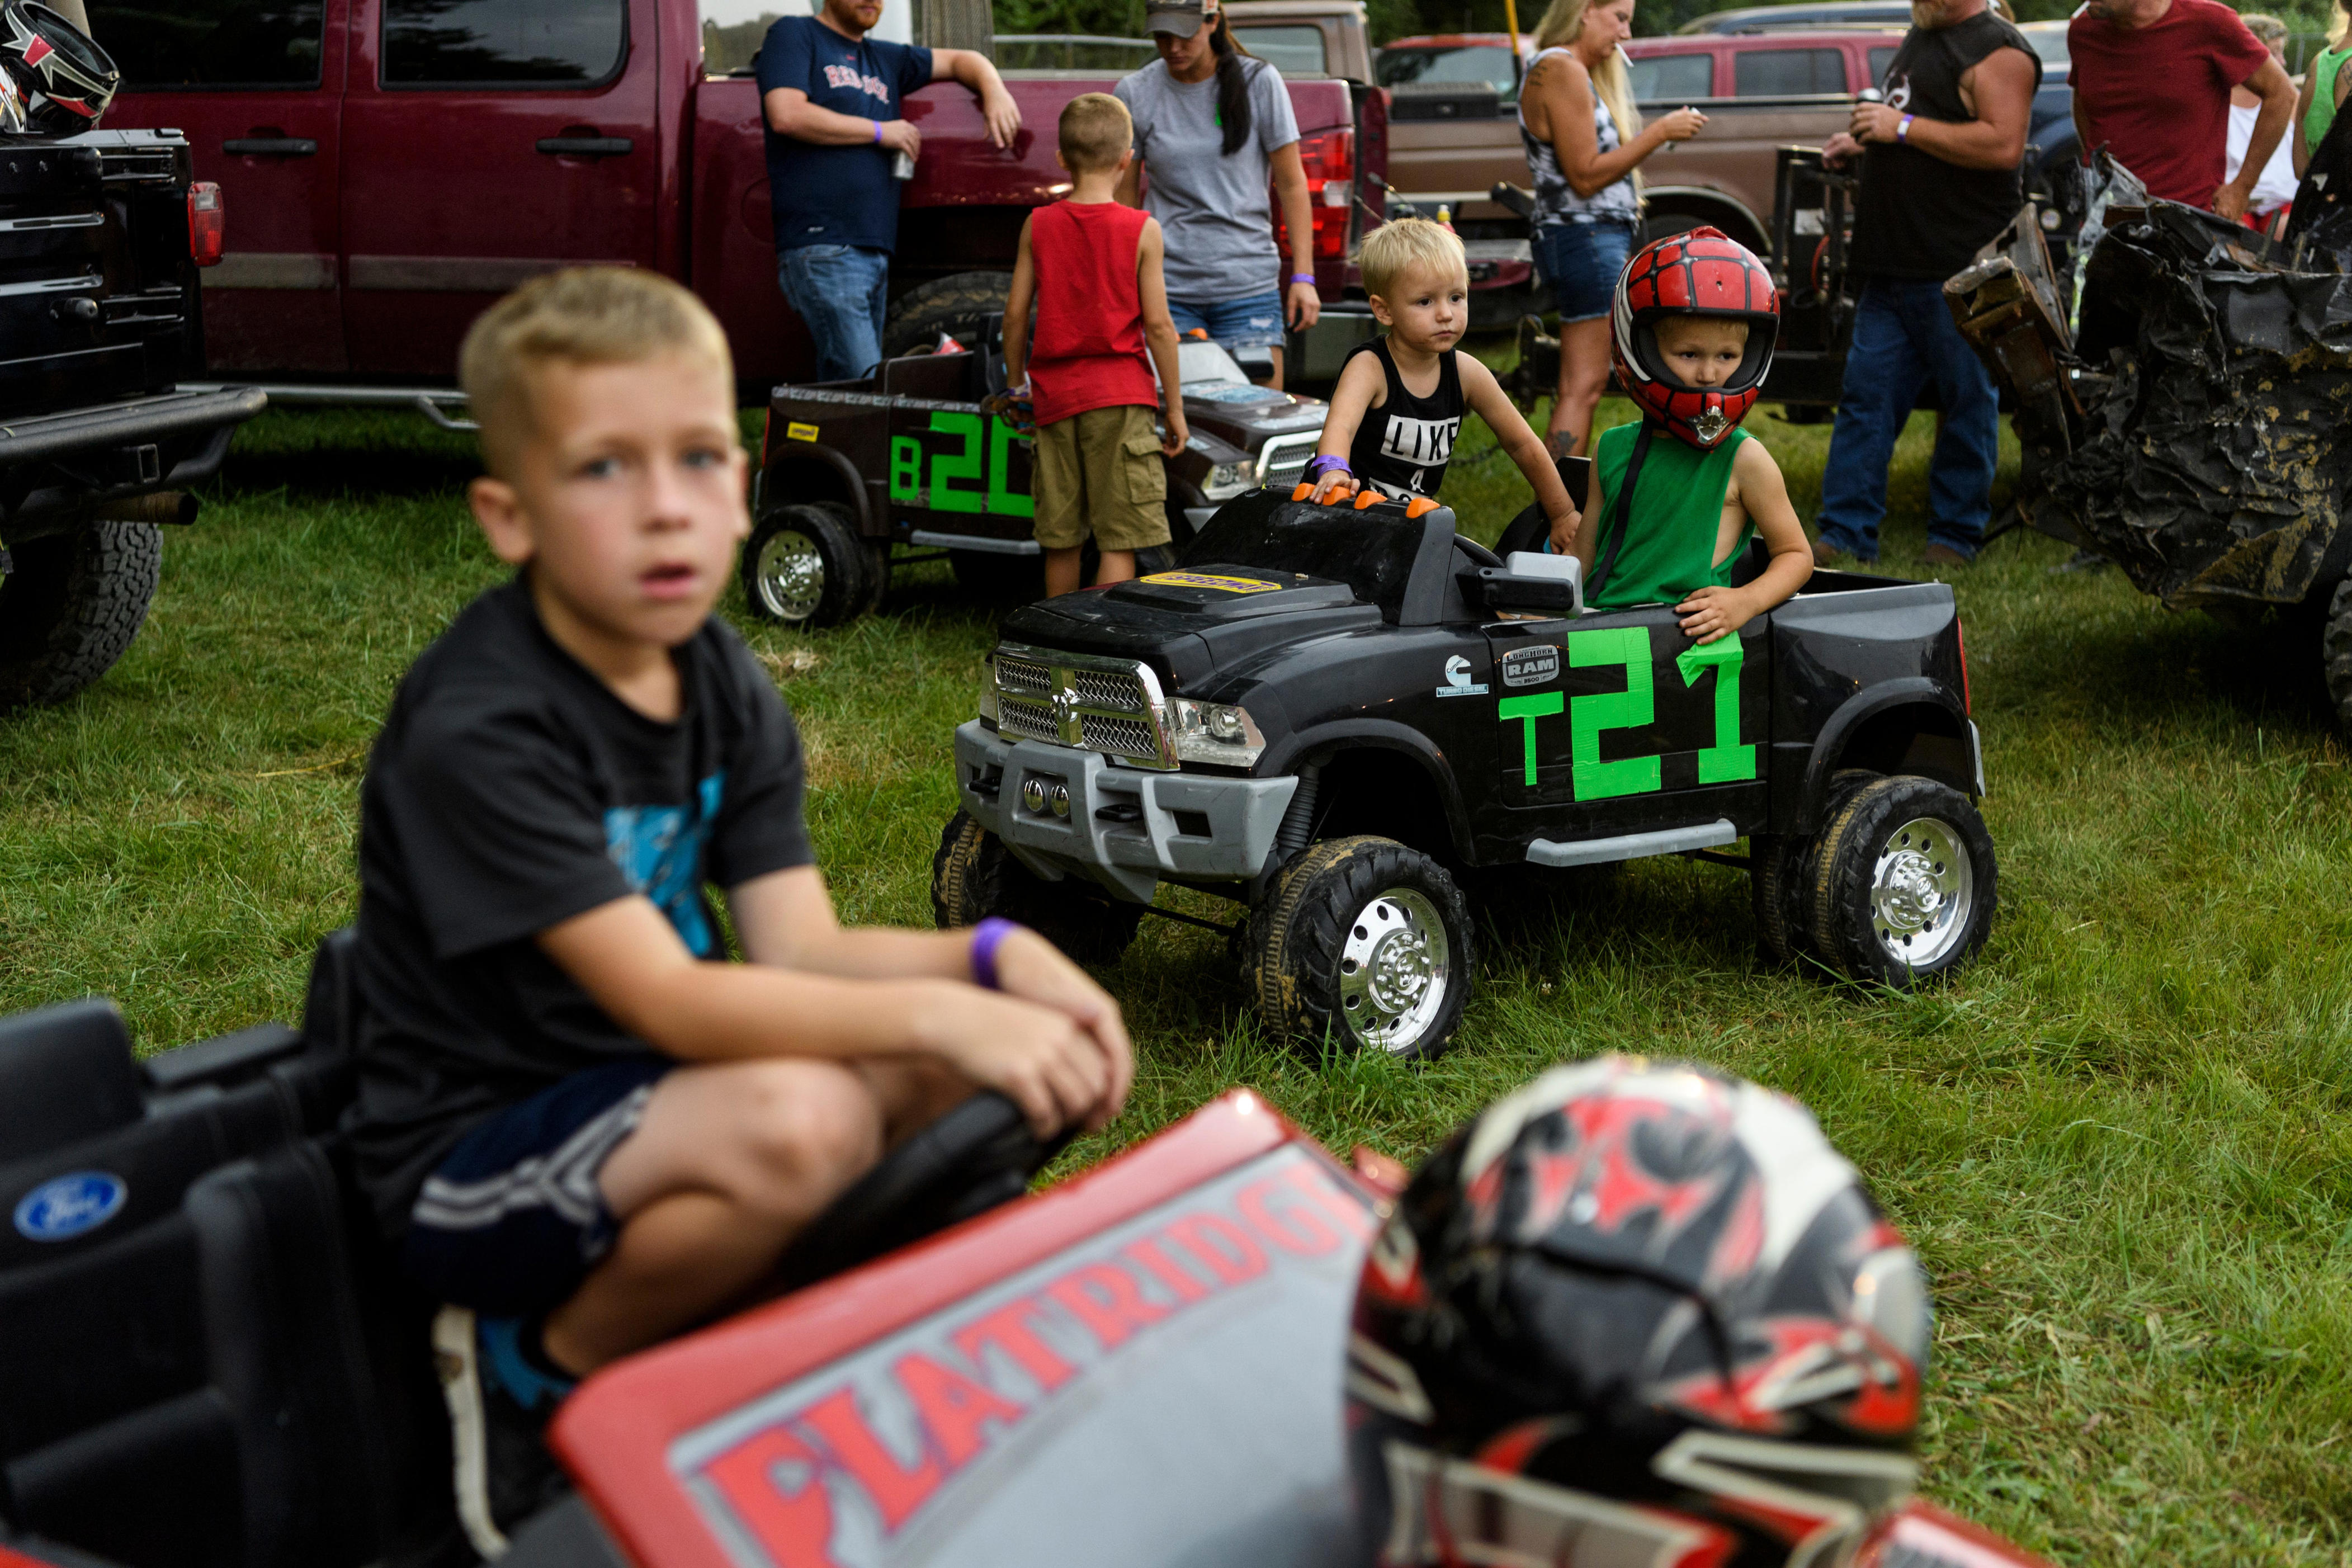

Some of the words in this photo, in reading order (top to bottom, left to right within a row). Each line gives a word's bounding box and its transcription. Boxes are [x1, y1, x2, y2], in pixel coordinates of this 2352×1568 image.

[1410, 469, 1425, 493] A
[1446, 658, 1465, 674] Cummi
[1508, 658, 1555, 677] RAM
[1498, 626, 1756, 802] T21
